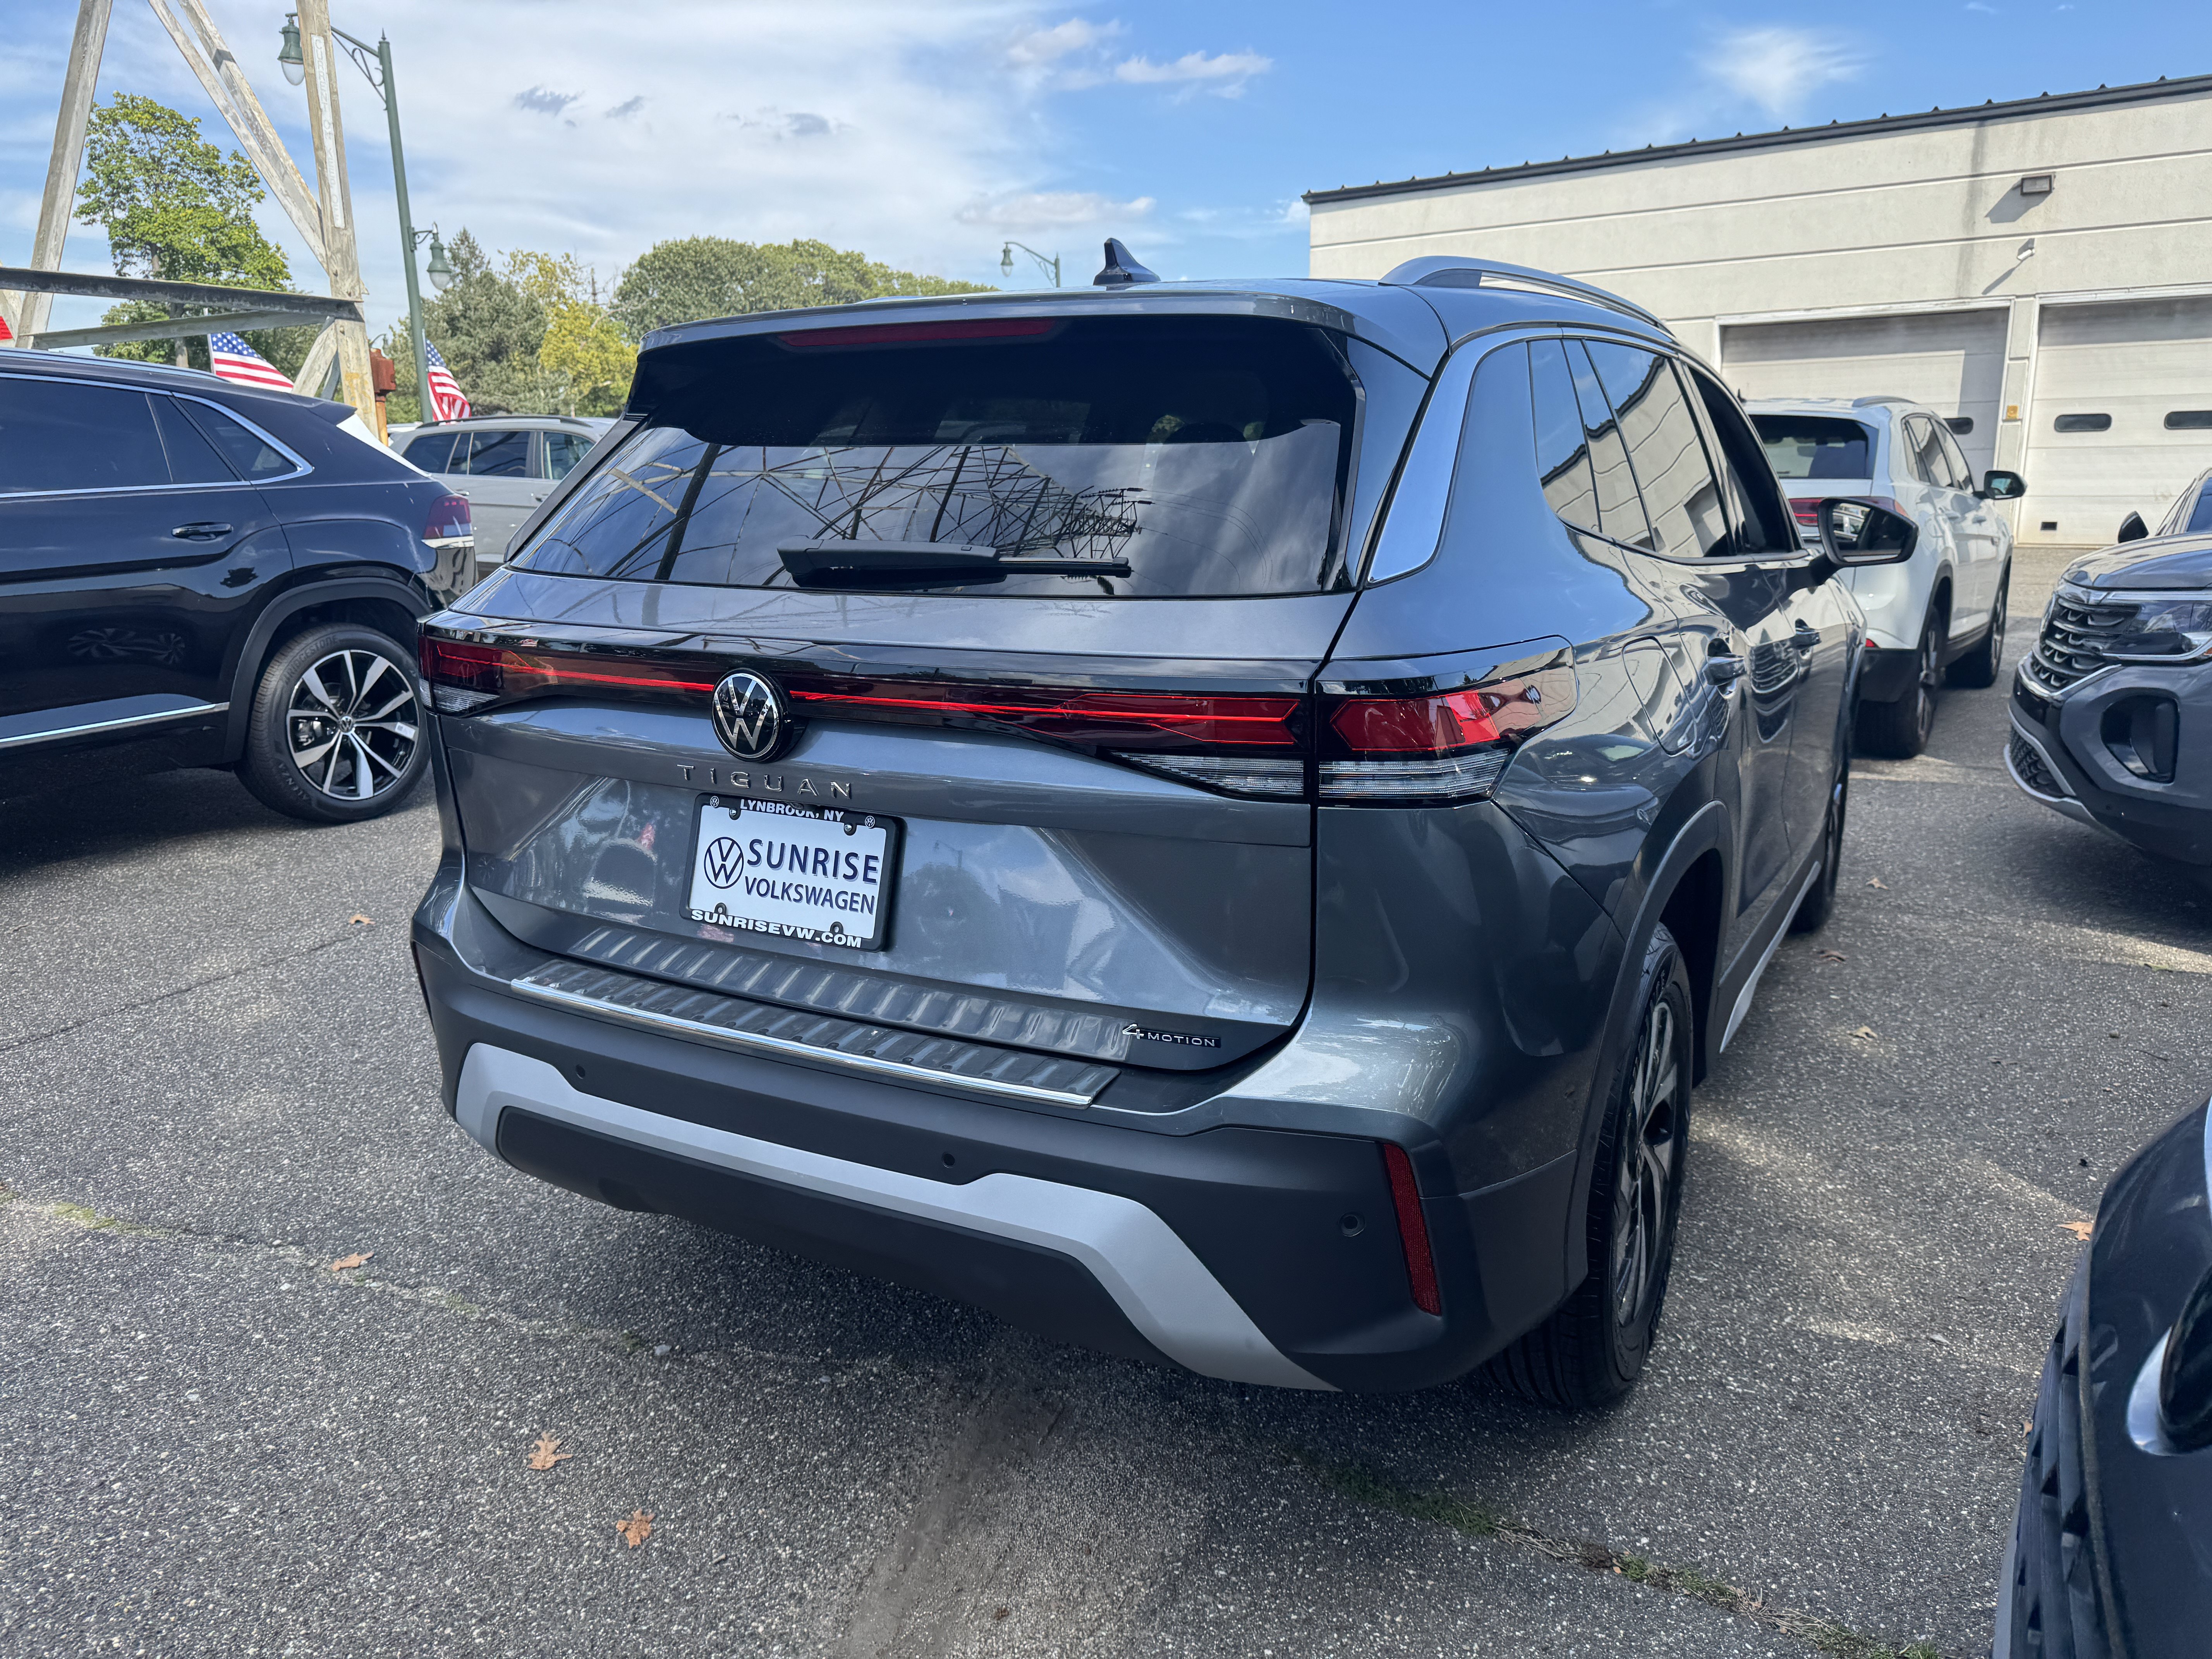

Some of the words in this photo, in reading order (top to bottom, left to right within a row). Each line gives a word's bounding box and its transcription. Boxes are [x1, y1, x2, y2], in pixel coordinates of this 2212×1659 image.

[315, 39, 328, 112] CURRENT
[714, 674, 778, 754] VW
[677, 764, 852, 799] TIGUAN
[824, 809, 844, 822] NY
[747, 839, 879, 885] SUNRISE
[745, 876, 874, 915] VOLKSWAGEN
[691, 910, 862, 948] SUNRISEVW.COM
[1122, 1024, 1215, 1046] 4MOTION
